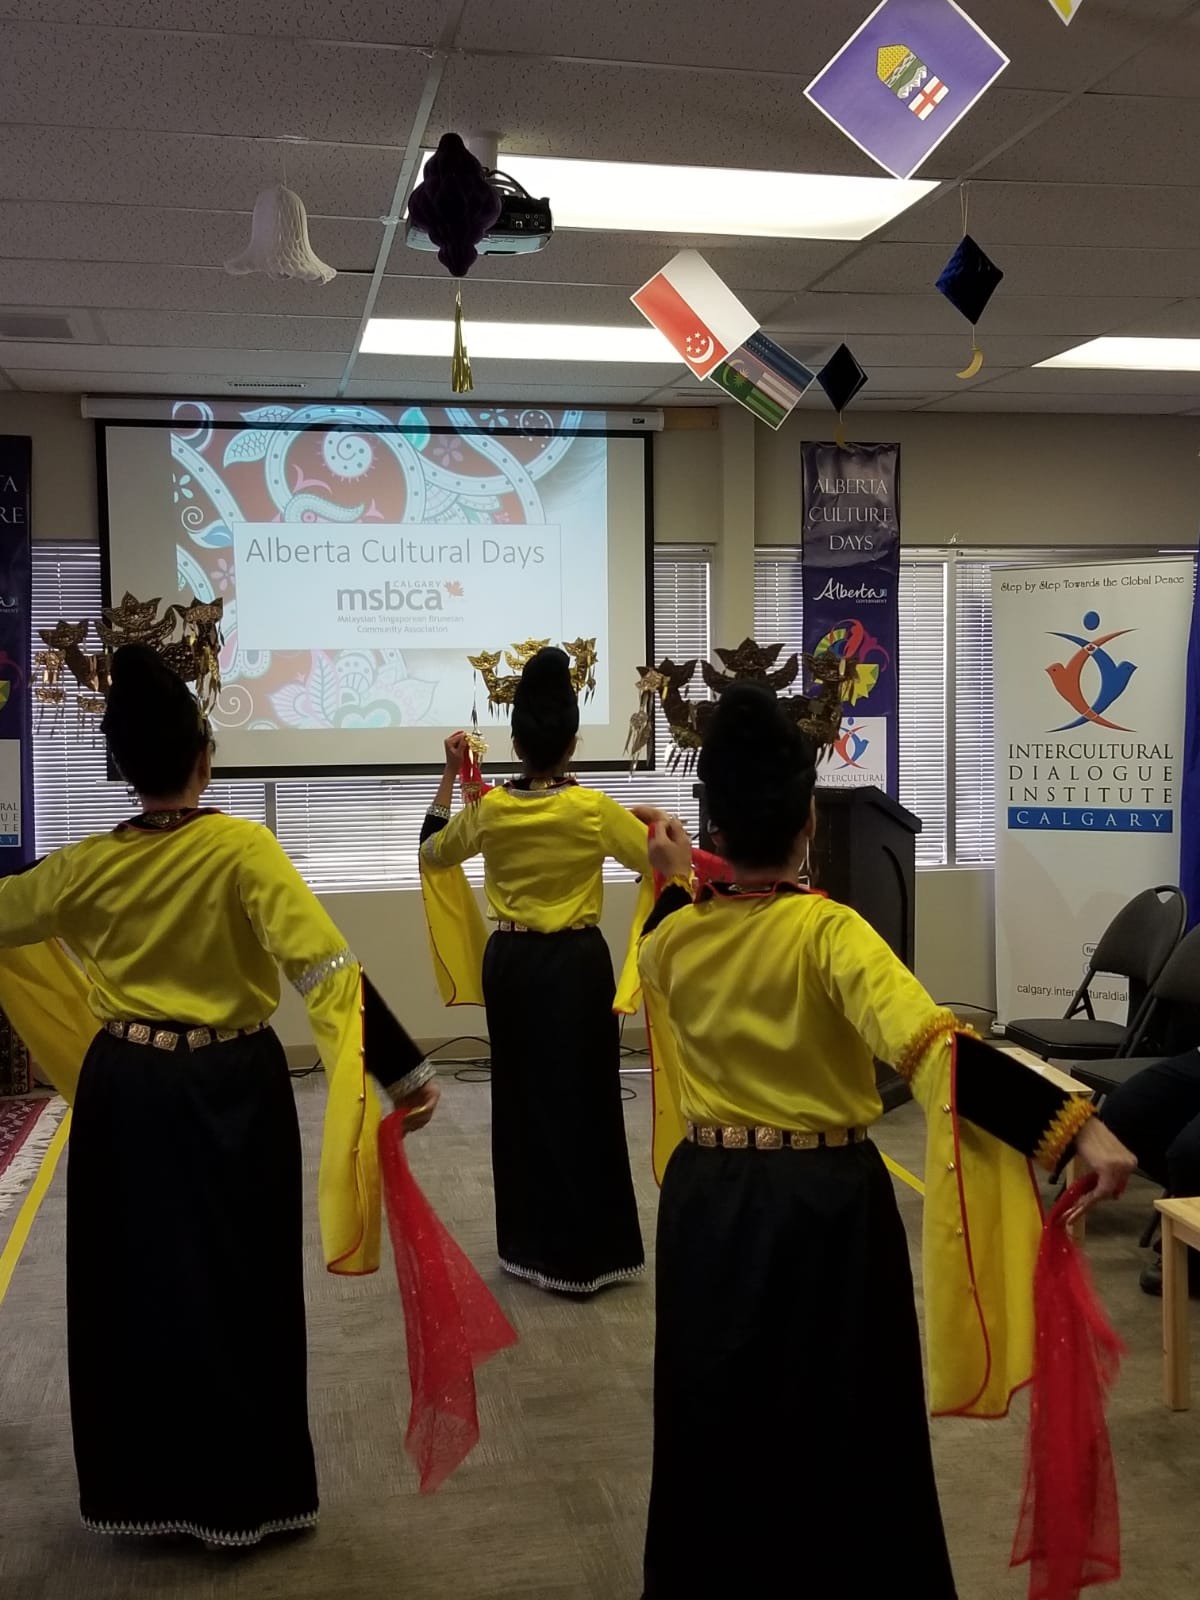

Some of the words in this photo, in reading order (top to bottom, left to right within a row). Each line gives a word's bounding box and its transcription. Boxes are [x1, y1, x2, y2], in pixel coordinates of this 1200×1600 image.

[813, 478, 888, 495] ALBERTA
[808, 506, 893, 523] CULTURE
[829, 535, 874, 551] DAYS
[246, 537, 351, 564] Alberta
[361, 538, 470, 565] Cultural
[482, 539, 545, 569] Days
[393, 580, 442, 588] CALGARY
[813, 577, 886, 601] Alberta
[1000, 582, 1022, 594] Step
[1025, 582, 1036, 593] by
[1039, 580, 1061, 592] Step
[1063, 578, 1100, 589] Towards
[1103, 577, 1118, 587] the
[1120, 575, 1151, 586] Global
[336, 581, 444, 611] msbca
[356, 625, 402, 634] Community
[403, 625, 449, 633] Association
[1008, 743, 1174, 760] INTERCULTURAL
[1008, 765, 1173, 782] DIALOGUE
[1008, 786, 1173, 804] INSTITUTE
[1016, 810, 1164, 827] CALGARY
